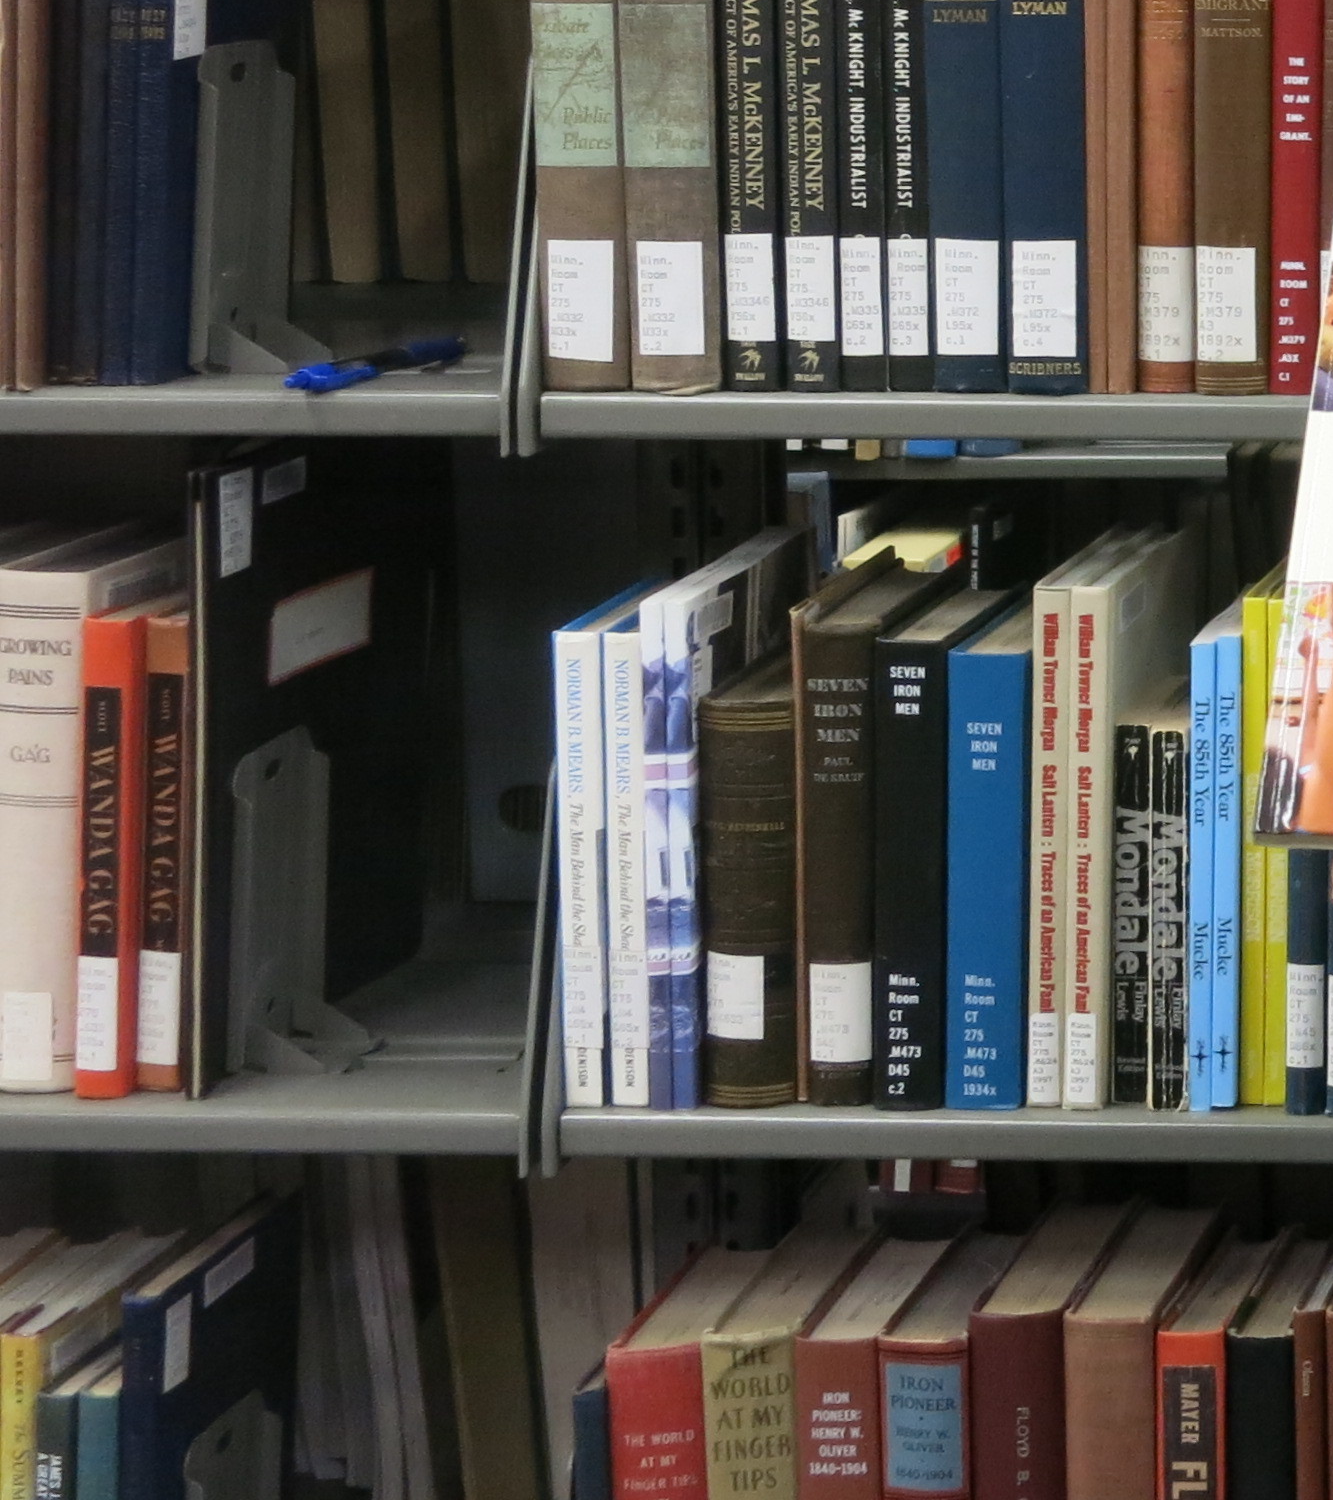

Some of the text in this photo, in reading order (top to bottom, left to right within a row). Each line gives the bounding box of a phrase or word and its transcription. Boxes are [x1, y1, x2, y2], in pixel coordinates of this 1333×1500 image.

[1012, 2, 1066, 16] LYMAN
[742, 56, 761, 74] L.
[742, 81, 764, 211] McKENNEY
[7, 667, 54, 686] PAINS
[889, 666, 926, 680] SEVEN
[1041, 613, 1059, 751] William Towner Morgan
[893, 684, 922, 698] IRON
[894, 702, 920, 716] MEN
[1194, 700, 1210, 827] The 85th Year
[87, 745, 116, 859] WANDA
[1114, 806, 1150, 976] Mondale
[1193, 922, 1209, 980] Mucke
[710, 1373, 791, 1398] WORLD
[822, 1392, 850, 1404] IRON
[716, 1404, 783, 1429] AT MY
[1180, 1383, 1200, 1444] MAYER
[811, 1426, 863, 1439] HENRY W.
[713, 1438, 791, 1462] FINGER
[819, 1445, 857, 1457] OLIVER
[729, 1468, 777, 1491] TIPS
[809, 1462, 868, 1475] 1840-1904
